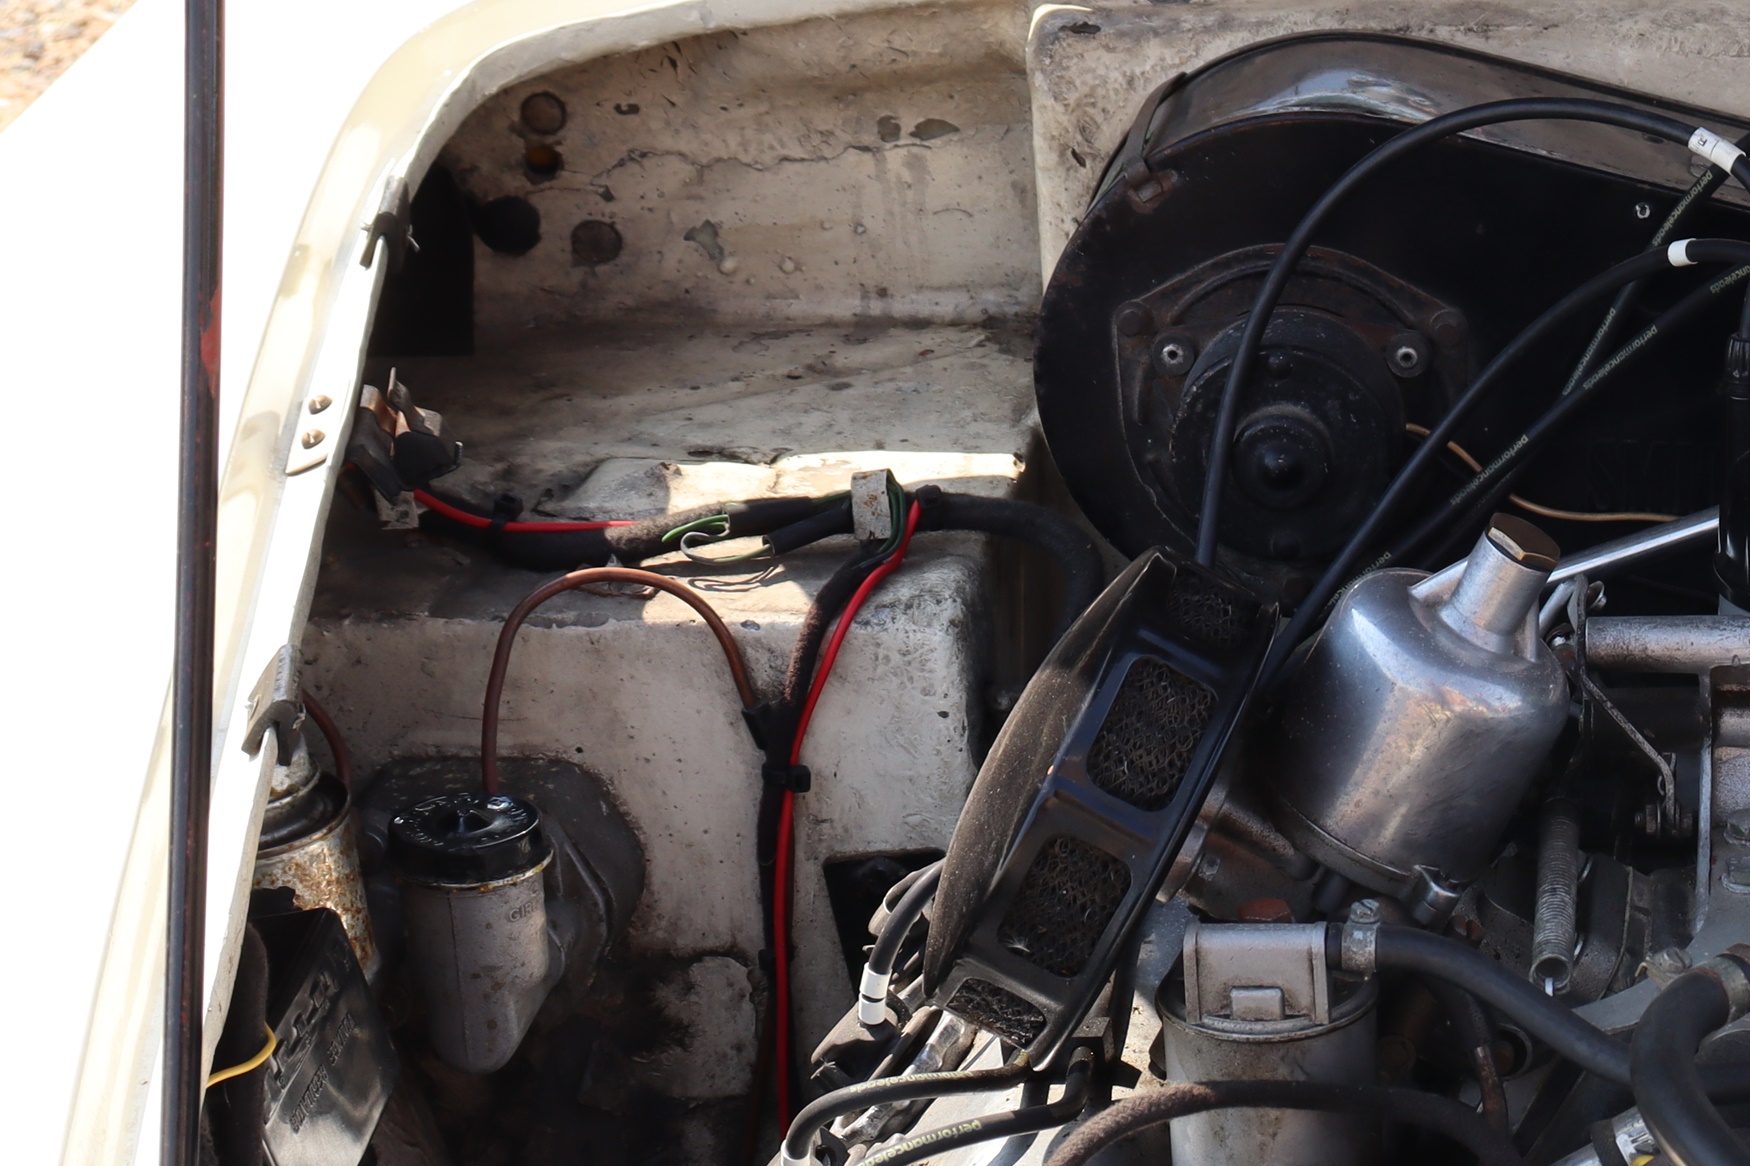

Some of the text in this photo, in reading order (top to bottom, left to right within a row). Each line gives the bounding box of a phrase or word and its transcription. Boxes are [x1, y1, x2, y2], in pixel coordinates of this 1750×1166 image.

[1651, 169, 1714, 247] performanceleads
[1582, 324, 1658, 391] performanceleads
[1448, 433, 1530, 505] performanceleads
[288, 1062, 329, 1135] REGULATOR
